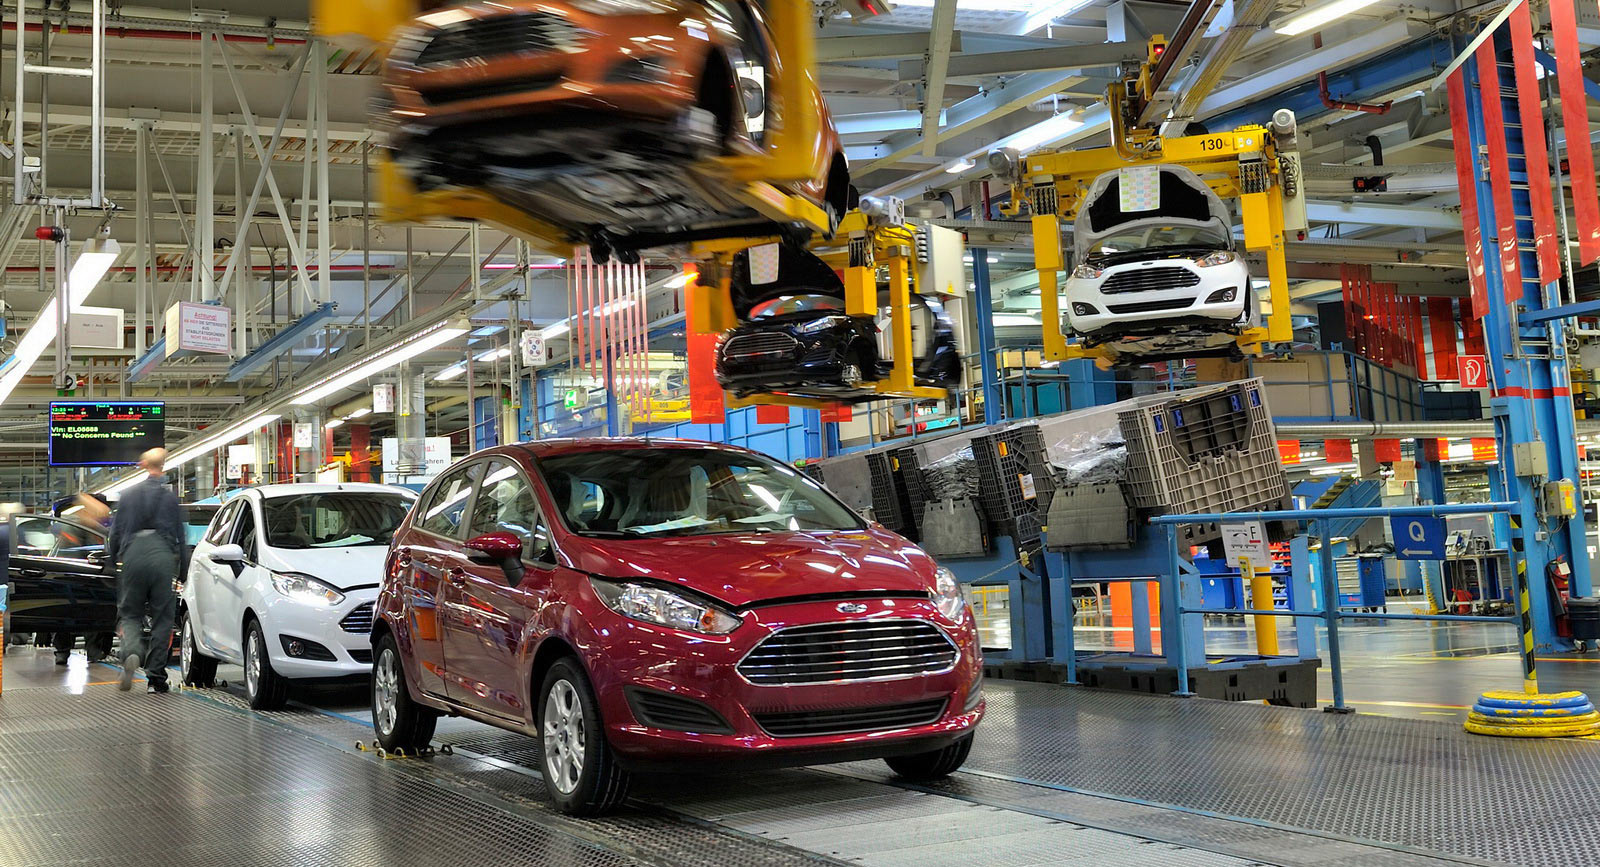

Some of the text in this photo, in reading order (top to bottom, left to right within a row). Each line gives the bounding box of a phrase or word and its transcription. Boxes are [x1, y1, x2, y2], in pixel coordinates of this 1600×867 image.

[1200, 138, 1223, 151] 130
[1250, 526, 1257, 539] F
[1408, 521, 1426, 542] Q
